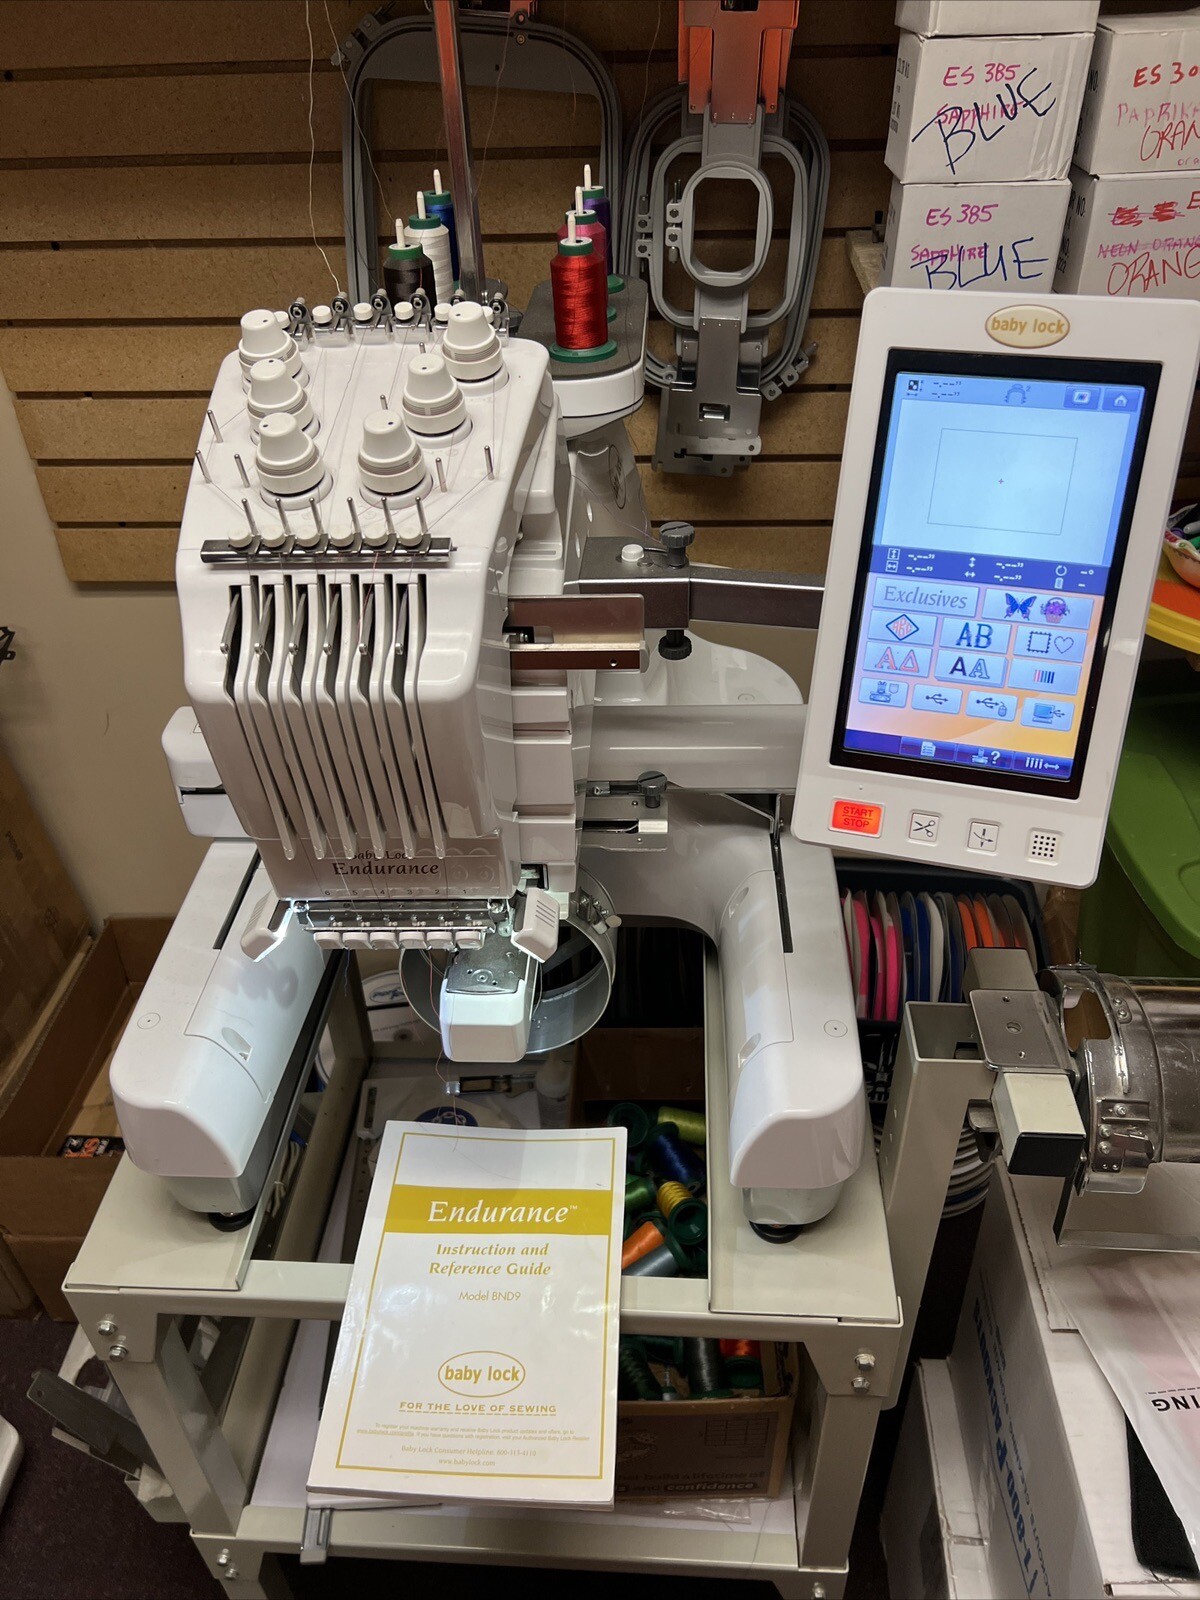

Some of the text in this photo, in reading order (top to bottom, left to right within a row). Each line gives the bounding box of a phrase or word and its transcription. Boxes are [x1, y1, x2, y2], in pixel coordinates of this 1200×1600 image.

[943, 62, 1021, 86] ES 385
[1133, 64, 1161, 88] ES
[911, 67, 1056, 175] BLUE
[926, 203, 999, 226] ES 385
[910, 237, 1049, 290] BLUE
[990, 316, 1065, 335] baby lock
[883, 585, 968, 609] Exclusives
[956, 622, 994, 649] AB
[842, 805, 874, 818] START
[843, 817, 870, 829] STOP
[352, 849, 415, 861] aby Loc
[331, 861, 439, 875] Endurance
[436, 1243, 549, 1256] Instruction and
[429, 1262, 551, 1277] Reference Guide
[459, 1291, 521, 1301] Model BND9
[444, 1365, 520, 1384] baby lock
[399, 1401, 557, 1413] FOR THE LOVE OF SEWING
[401, 1445, 416, 1453] Baby
[434, 1446, 465, 1454] Consumer
